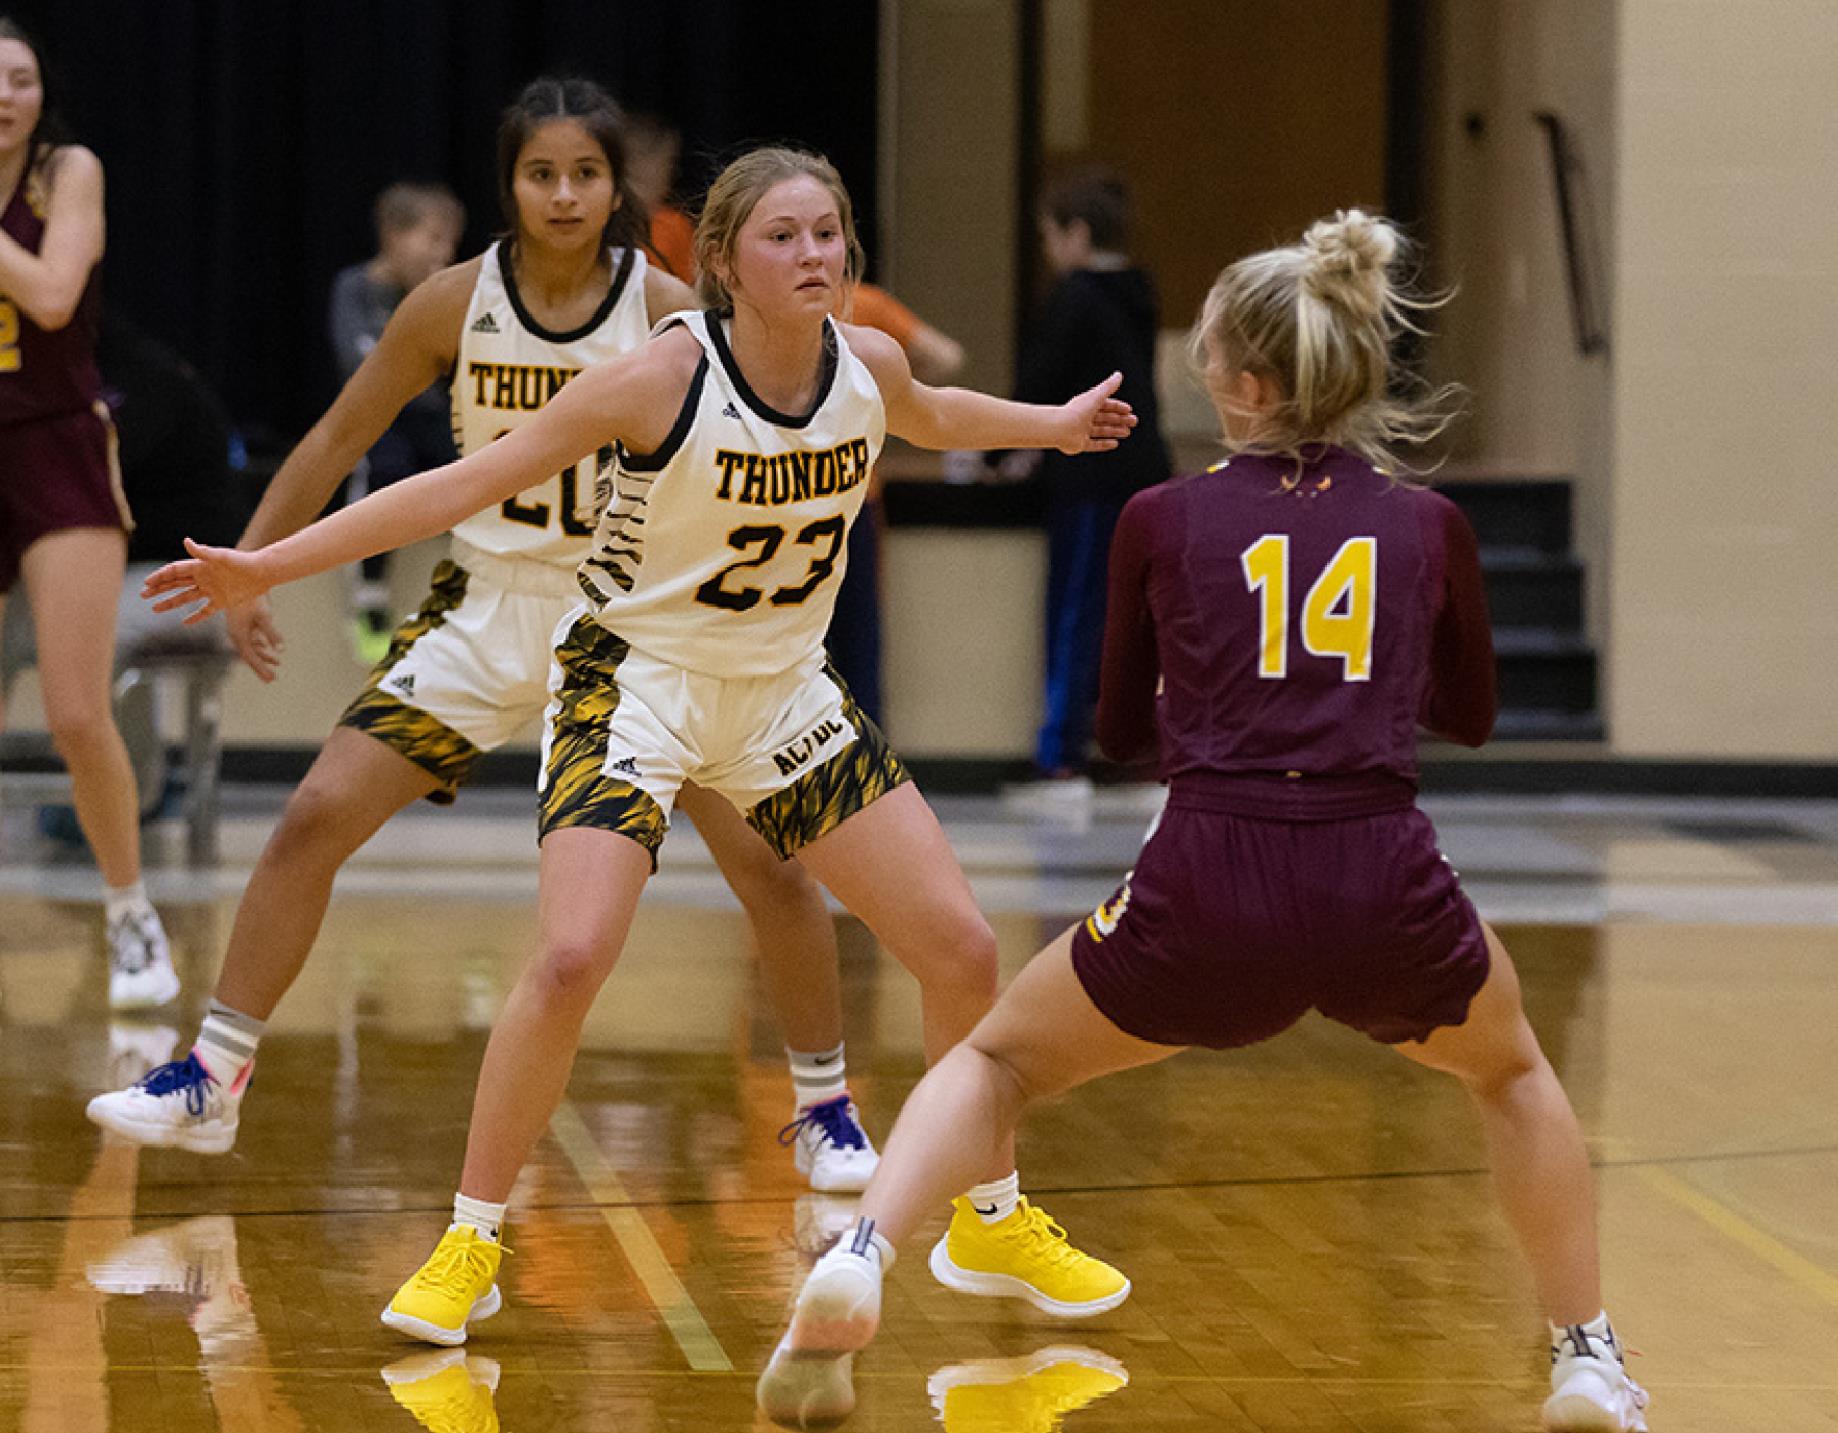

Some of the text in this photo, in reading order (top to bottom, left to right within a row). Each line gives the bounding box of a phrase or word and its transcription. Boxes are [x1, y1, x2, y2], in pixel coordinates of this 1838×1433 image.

[468, 361, 584, 411] THUN
[715, 436, 869, 506] THUNDER
[695, 512, 846, 612] 23
[1240, 534, 1377, 681] 14
